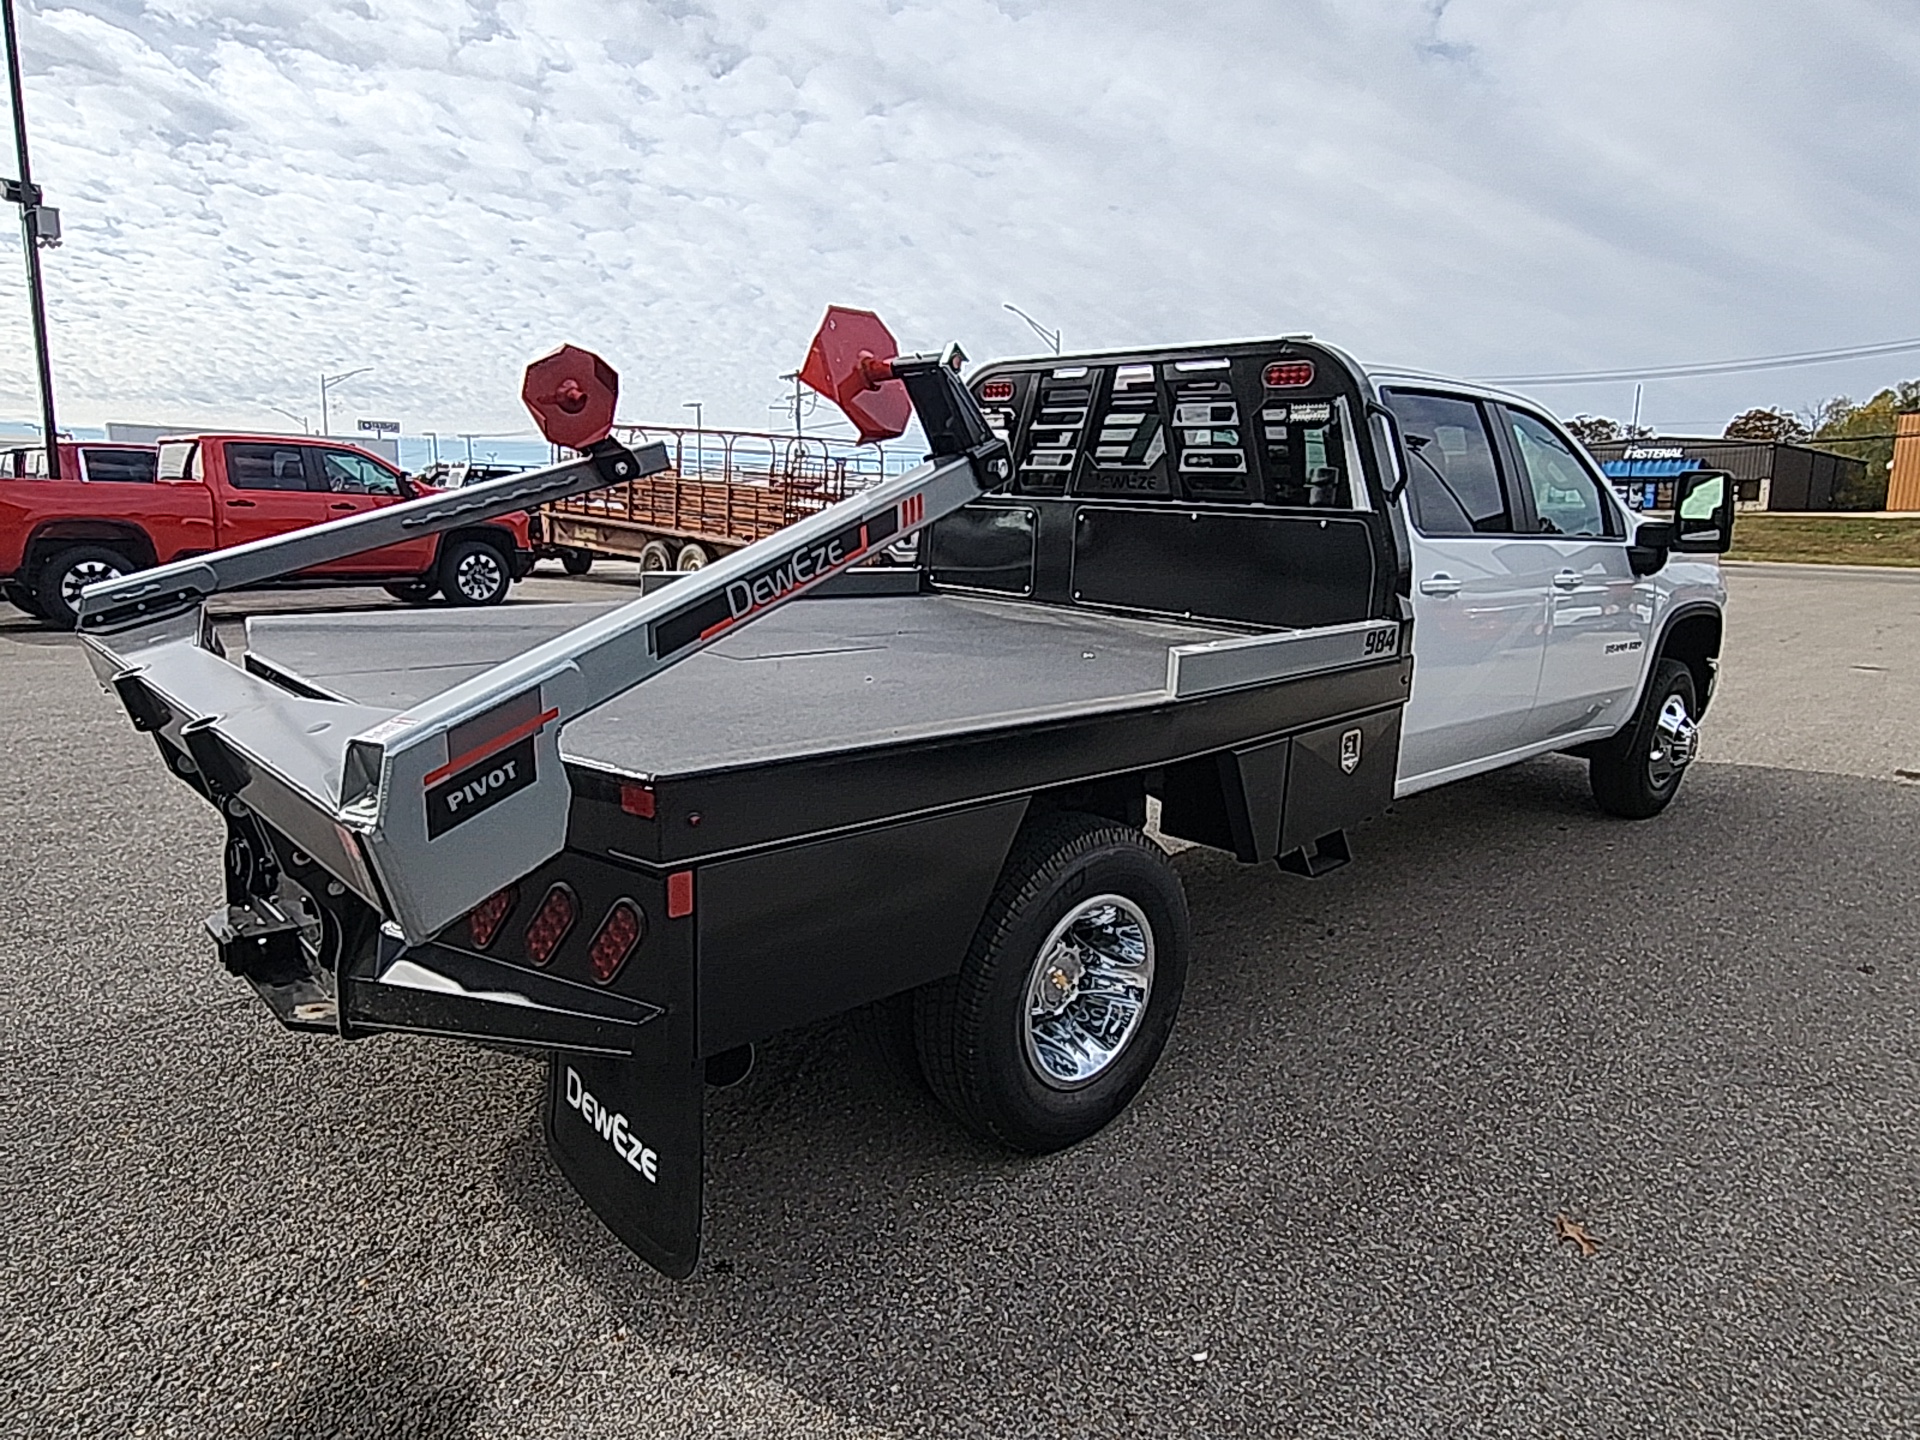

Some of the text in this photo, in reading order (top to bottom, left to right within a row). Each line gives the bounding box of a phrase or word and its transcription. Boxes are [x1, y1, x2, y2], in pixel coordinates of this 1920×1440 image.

[1623, 445, 1684, 459] FASTENAL
[1364, 628, 1396, 656] 984
[446, 760, 517, 812] PIVOT
